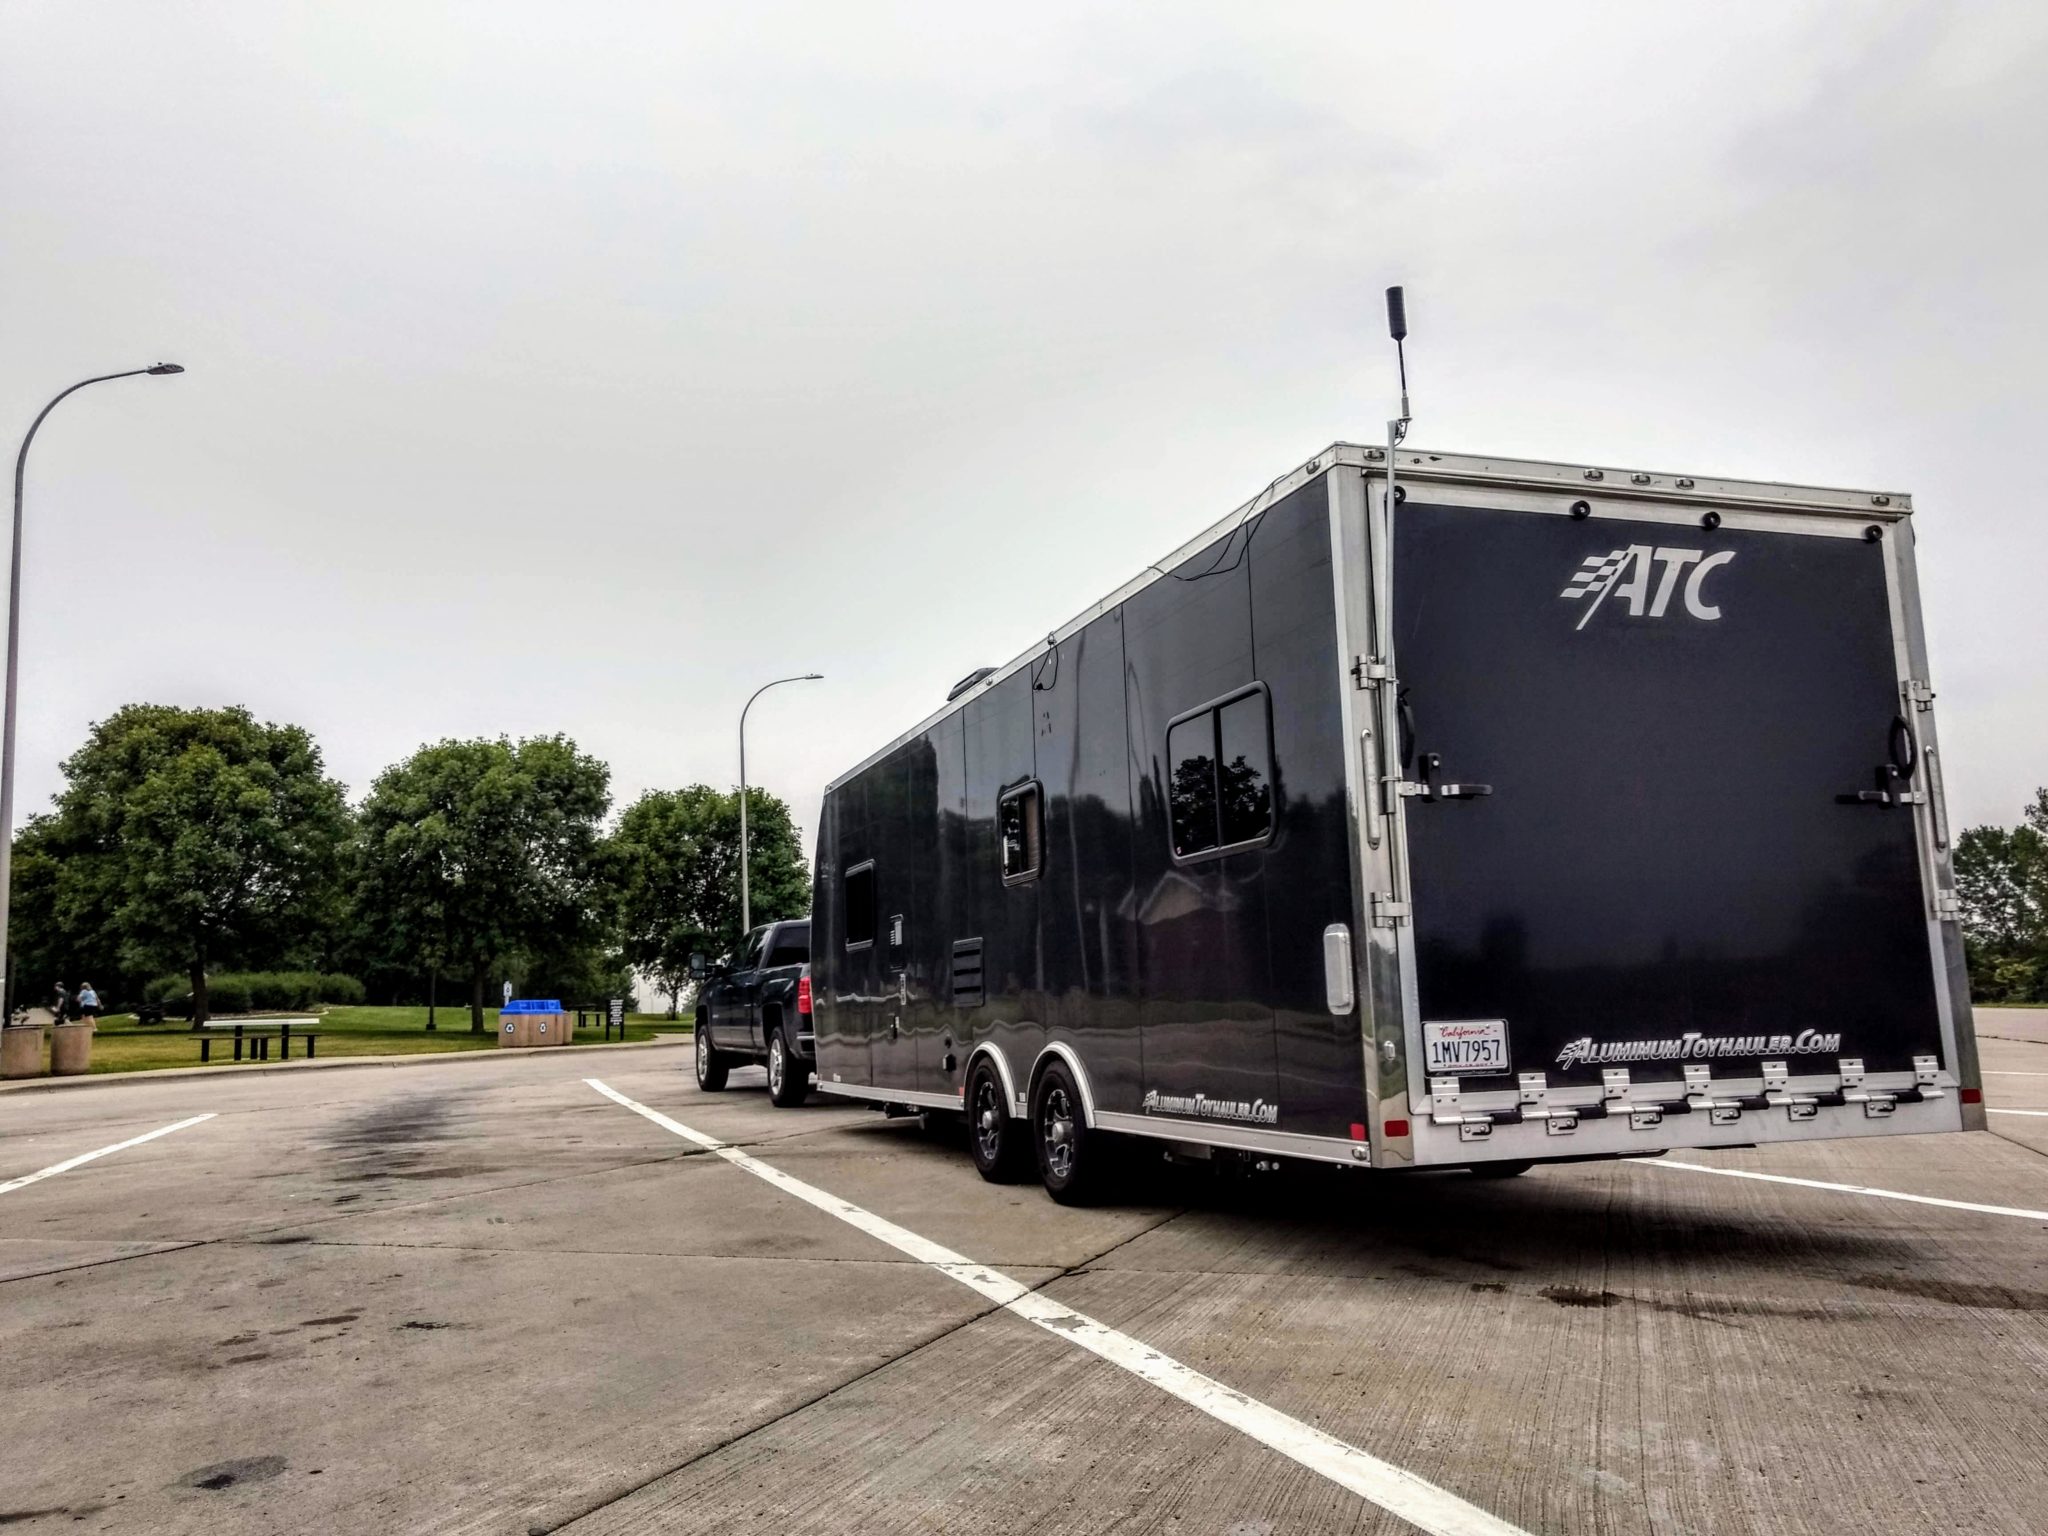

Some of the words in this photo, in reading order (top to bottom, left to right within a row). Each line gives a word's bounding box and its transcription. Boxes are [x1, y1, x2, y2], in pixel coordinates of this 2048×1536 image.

[1572, 544, 1737, 631] ATC
[1440, 1026, 1489, 1039] California
[1432, 1040, 1500, 1063] 1MV7957
